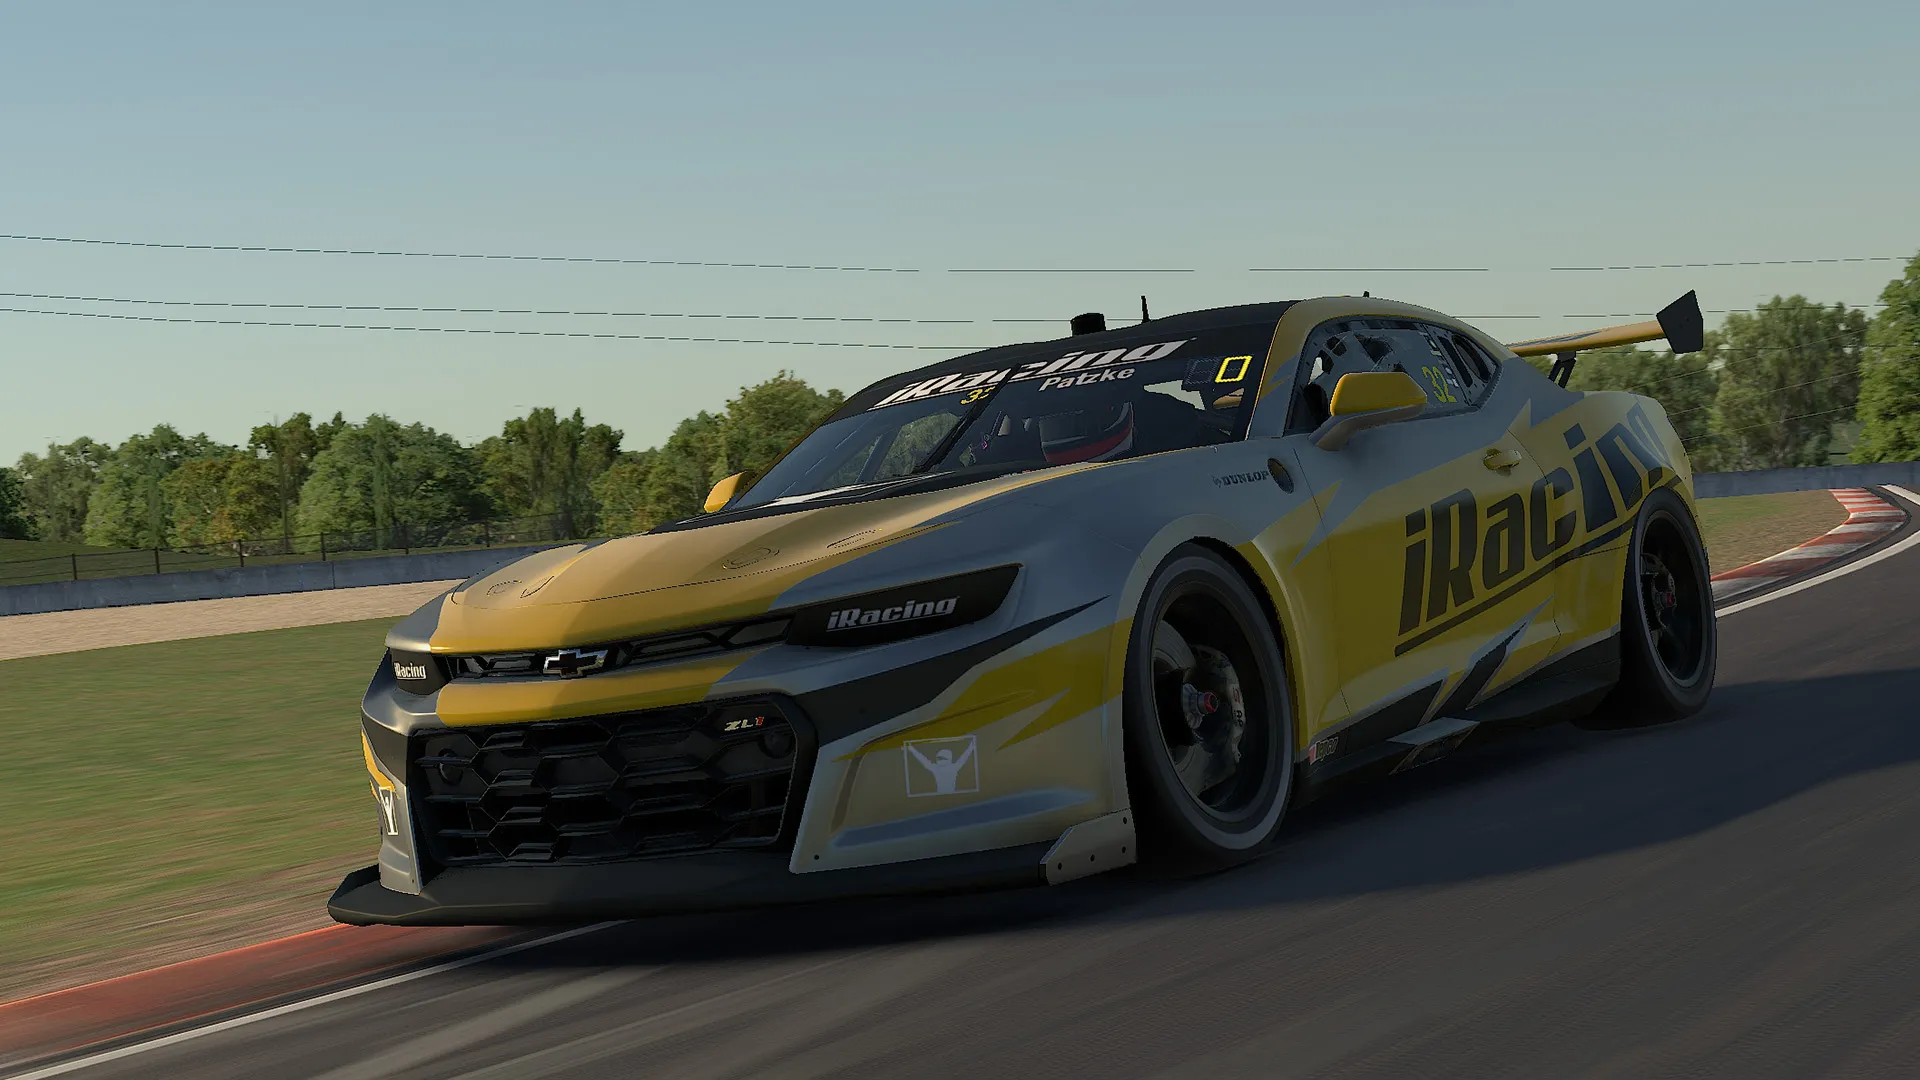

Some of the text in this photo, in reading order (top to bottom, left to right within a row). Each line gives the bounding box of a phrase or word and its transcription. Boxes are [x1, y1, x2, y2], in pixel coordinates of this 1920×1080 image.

[867, 339, 1190, 411] iRacing
[1039, 367, 1135, 391] Patzke
[1421, 366, 1457, 403] 32
[1222, 470, 1269, 486] DUNLOP
[826, 596, 960, 632] iRacing
